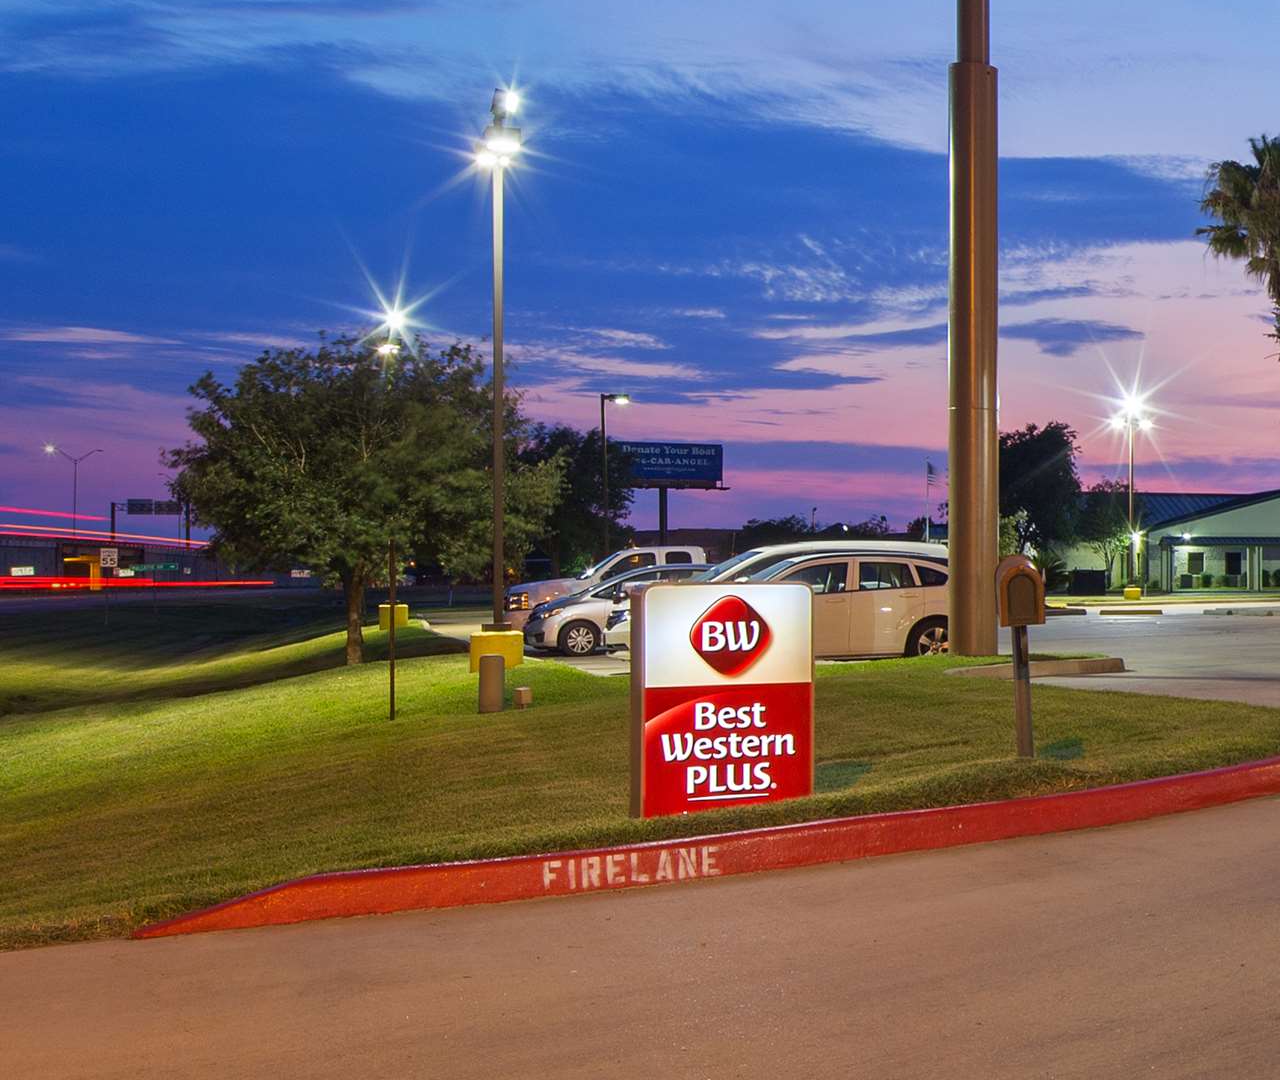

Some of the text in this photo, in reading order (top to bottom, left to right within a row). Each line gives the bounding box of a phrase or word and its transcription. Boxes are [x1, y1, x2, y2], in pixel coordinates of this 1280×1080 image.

[701, 620, 760, 653] BW
[694, 702, 767, 731] Best
[660, 733, 796, 762] Western
